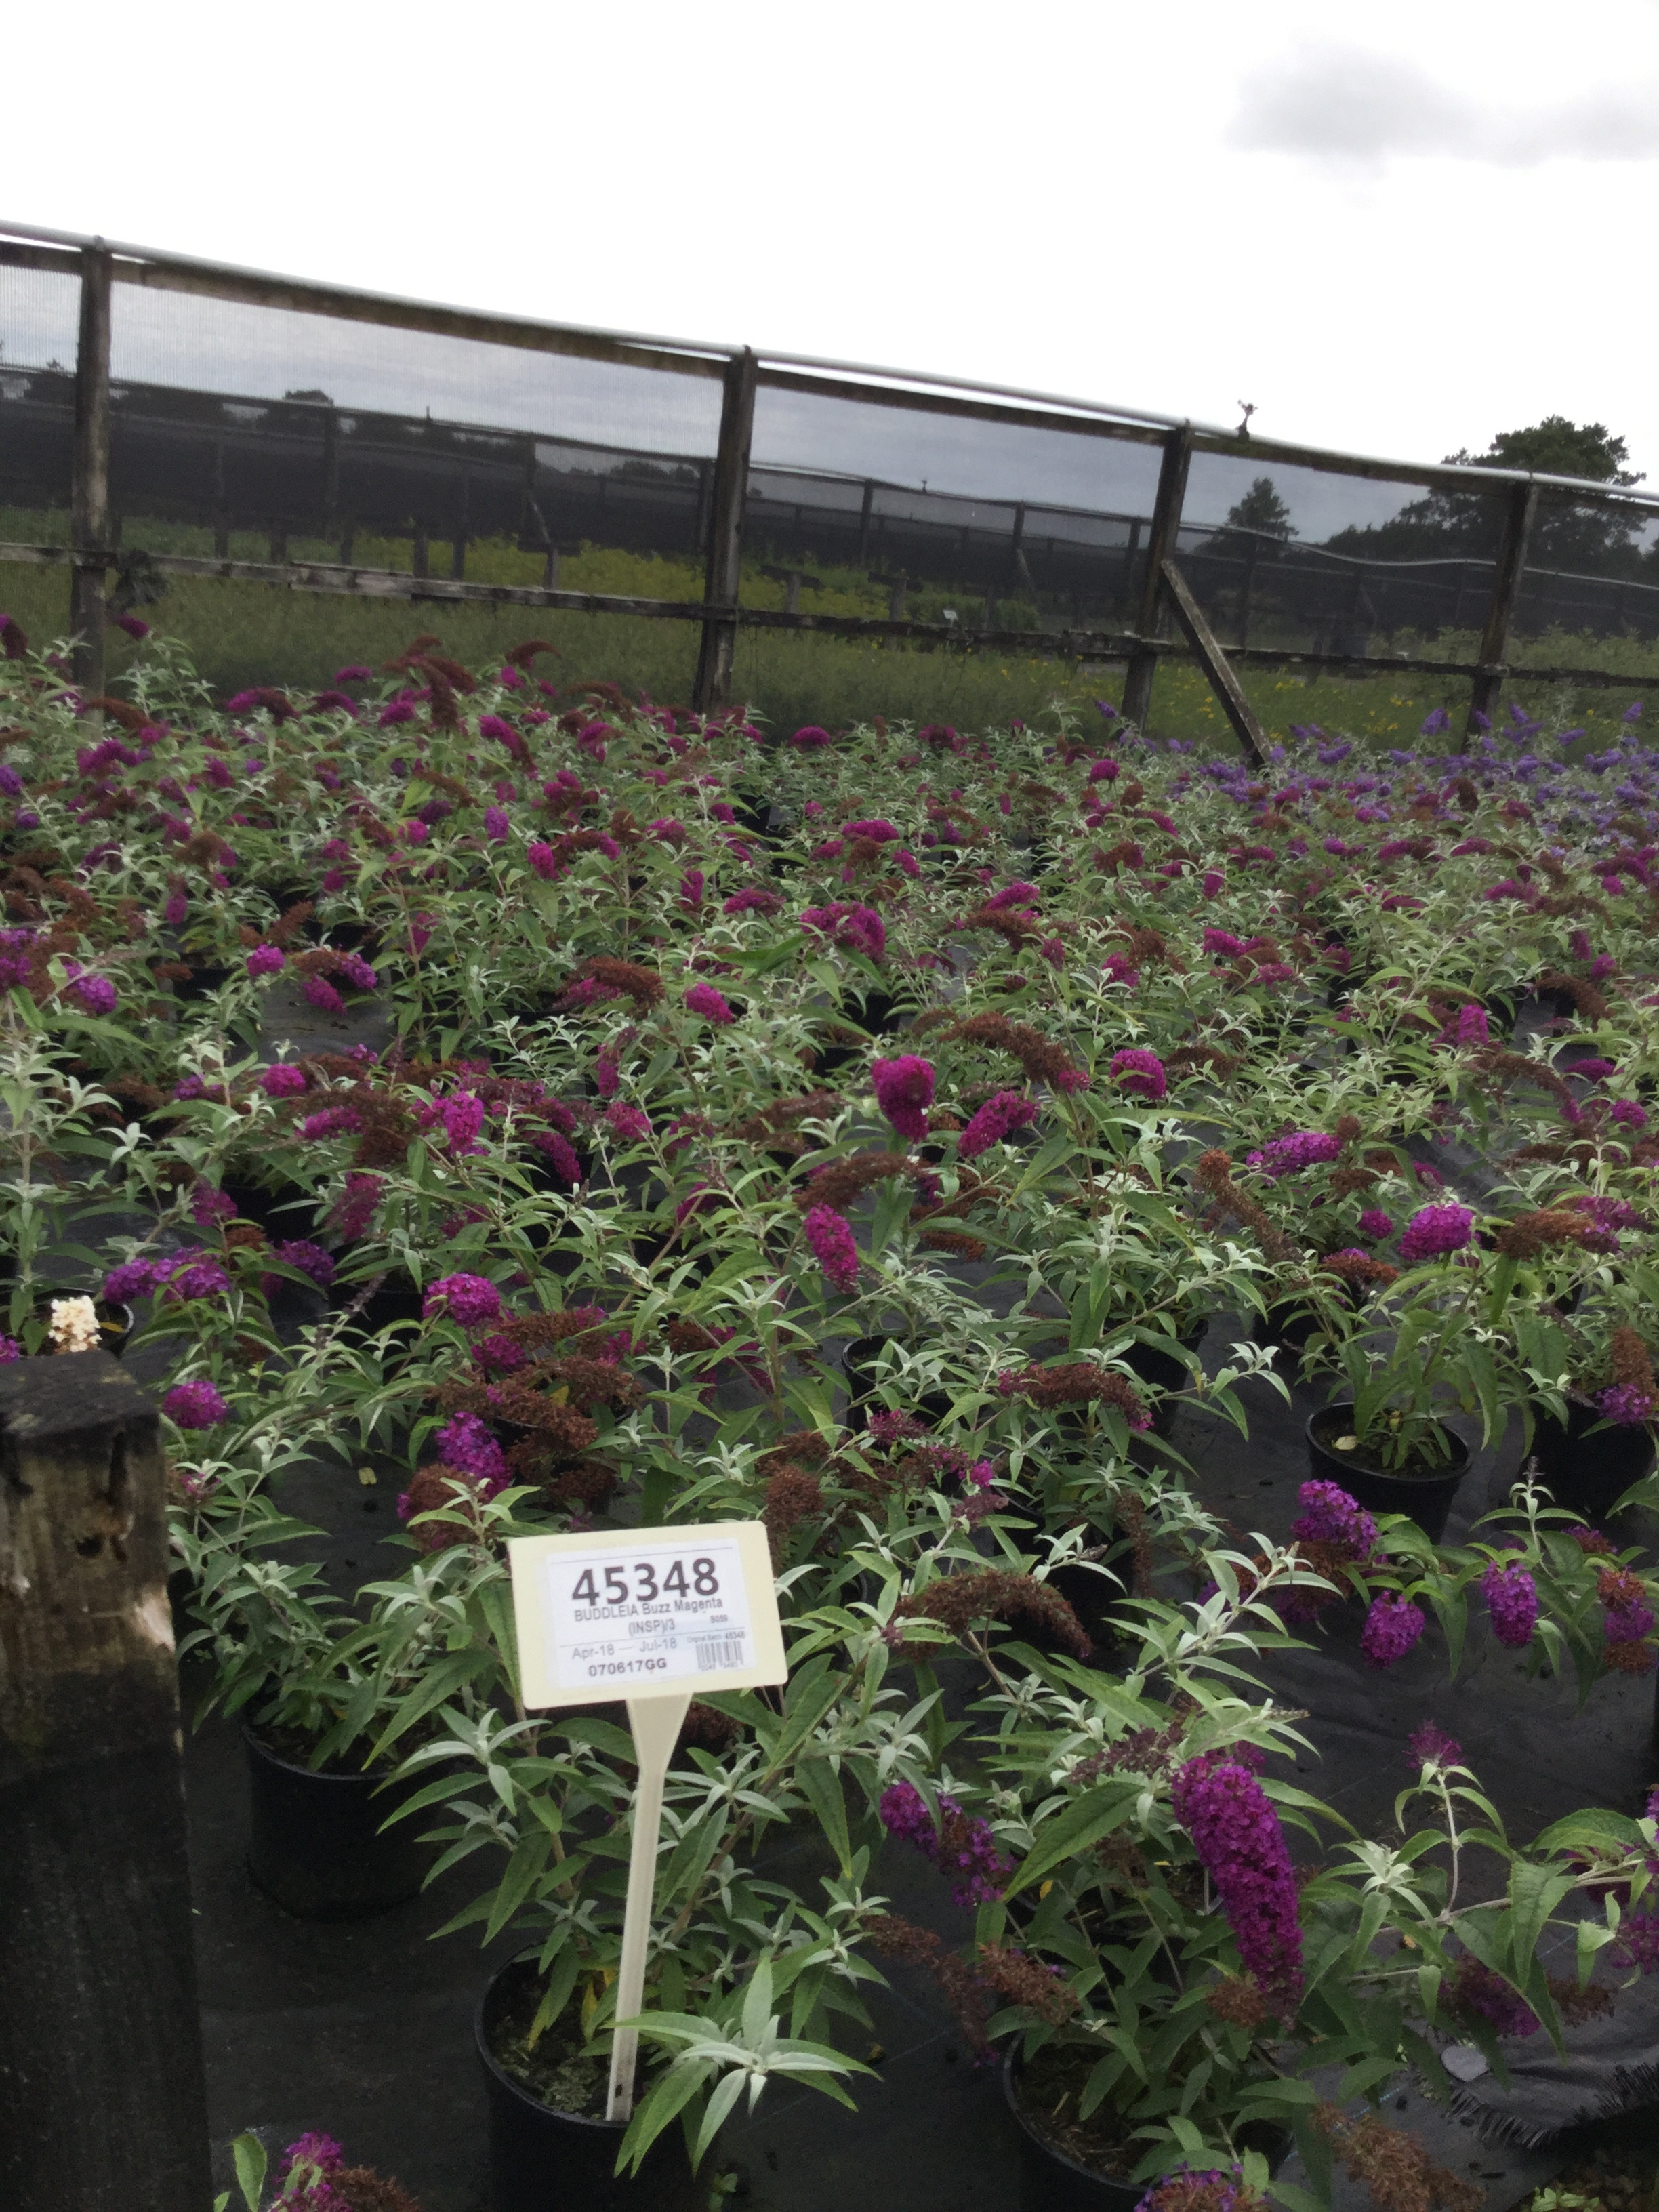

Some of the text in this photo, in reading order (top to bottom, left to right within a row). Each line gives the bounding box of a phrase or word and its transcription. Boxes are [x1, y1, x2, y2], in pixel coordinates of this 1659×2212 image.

[571, 1558, 719, 1607] 45348
[574, 1597, 723, 1622] BUDDLEIA Buzz Magenta
[572, 1637, 678, 1660] Apr-18 Jul-18
[588, 1658, 667, 1677] 070617GG
